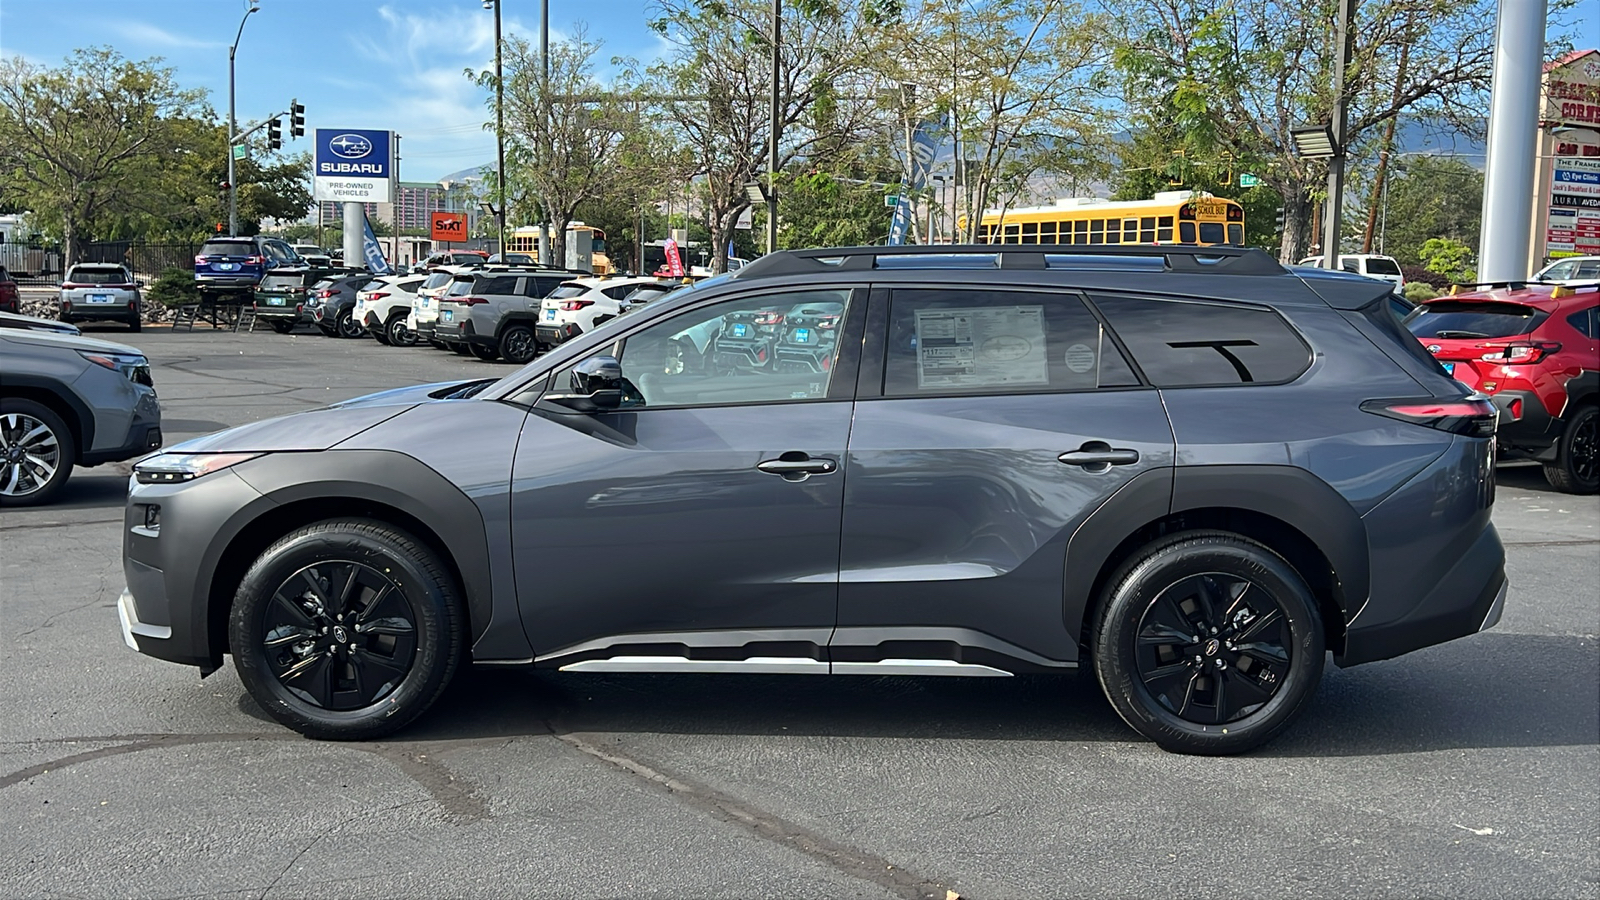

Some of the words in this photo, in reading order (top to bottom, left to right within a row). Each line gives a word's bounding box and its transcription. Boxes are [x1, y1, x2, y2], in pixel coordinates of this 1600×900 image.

[321, 162, 382, 174] SUBARU
[1571, 172, 1582, 182] Eye
[1583, 174, 1599, 182] Clinic
[1553, 184, 1567, 192] Jack's
[333, 189, 369, 197] VEHICLES
[1554, 196, 1577, 205] AURA
[1198, 205, 1215, 214] SCHOOL
[1216, 206, 1225, 215] BUS
